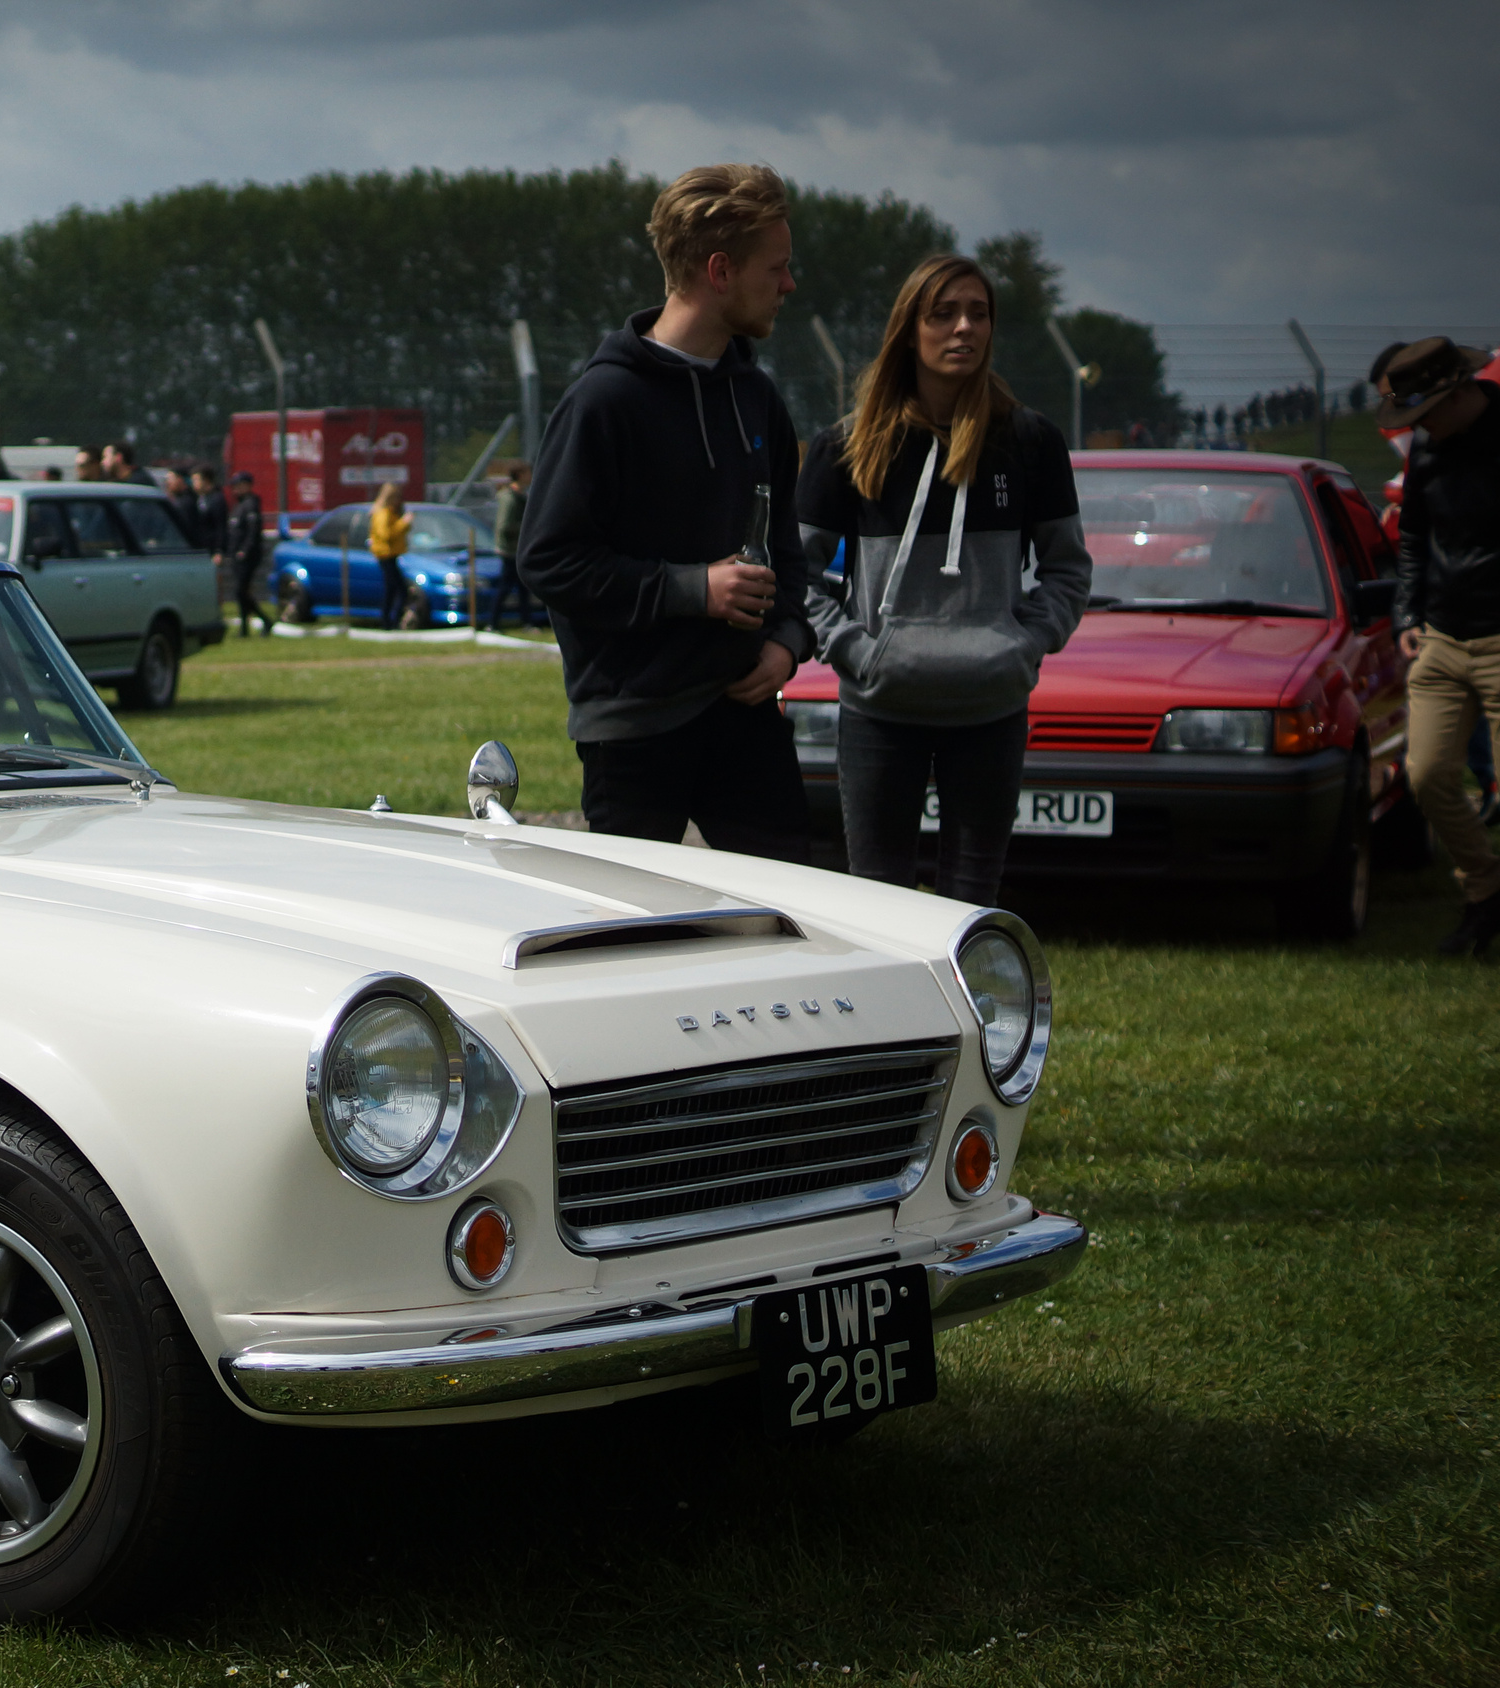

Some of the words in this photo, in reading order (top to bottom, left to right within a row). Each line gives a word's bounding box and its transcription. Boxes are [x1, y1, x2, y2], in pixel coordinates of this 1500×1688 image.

[994, 473, 1007, 488] SC
[1032, 791, 1107, 824] RUD
[676, 997, 855, 1032] DATSUN
[798, 1278, 892, 1353] UWP
[787, 1340, 910, 1427] 228F
